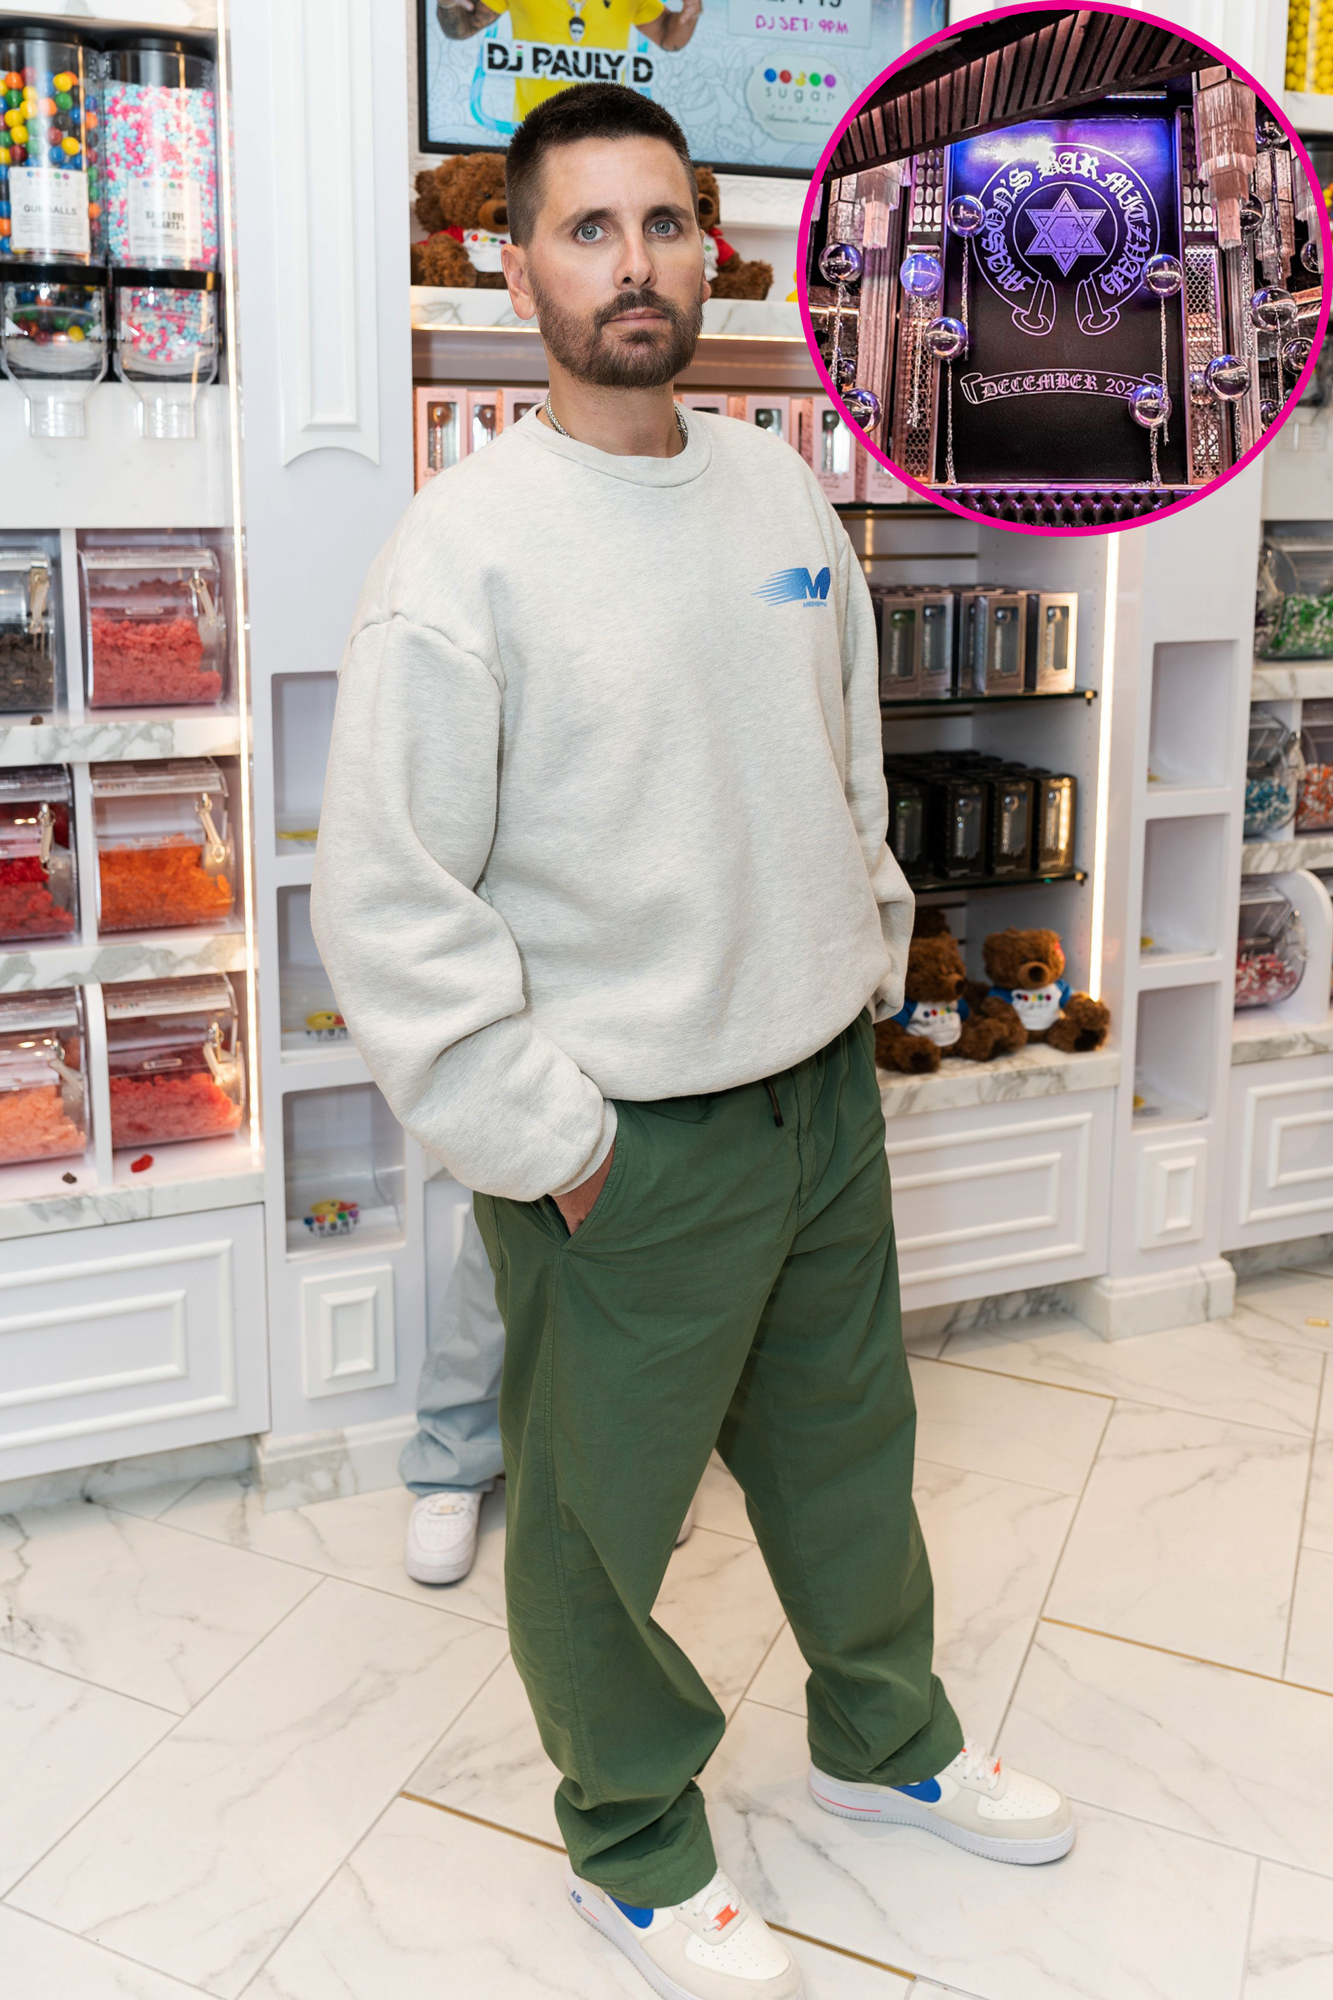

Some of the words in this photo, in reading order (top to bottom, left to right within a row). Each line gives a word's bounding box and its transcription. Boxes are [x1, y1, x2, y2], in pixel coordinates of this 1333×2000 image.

[755, 14, 776, 30] DJ
[818, 19, 849, 34] 9PM
[532, 47, 625, 80] PAULY
[633, 57, 653, 82] D
[764, 86, 836, 103] sugar
[151, 220, 180, 230] HARTS
[981, 167, 1035, 292] MASON'S
[1036, 151, 1100, 182] BAR
[1096, 171, 1152, 297] MITZVAH
[981, 373, 1098, 399] DECEMBER
[1104, 378, 1143, 397] 202
